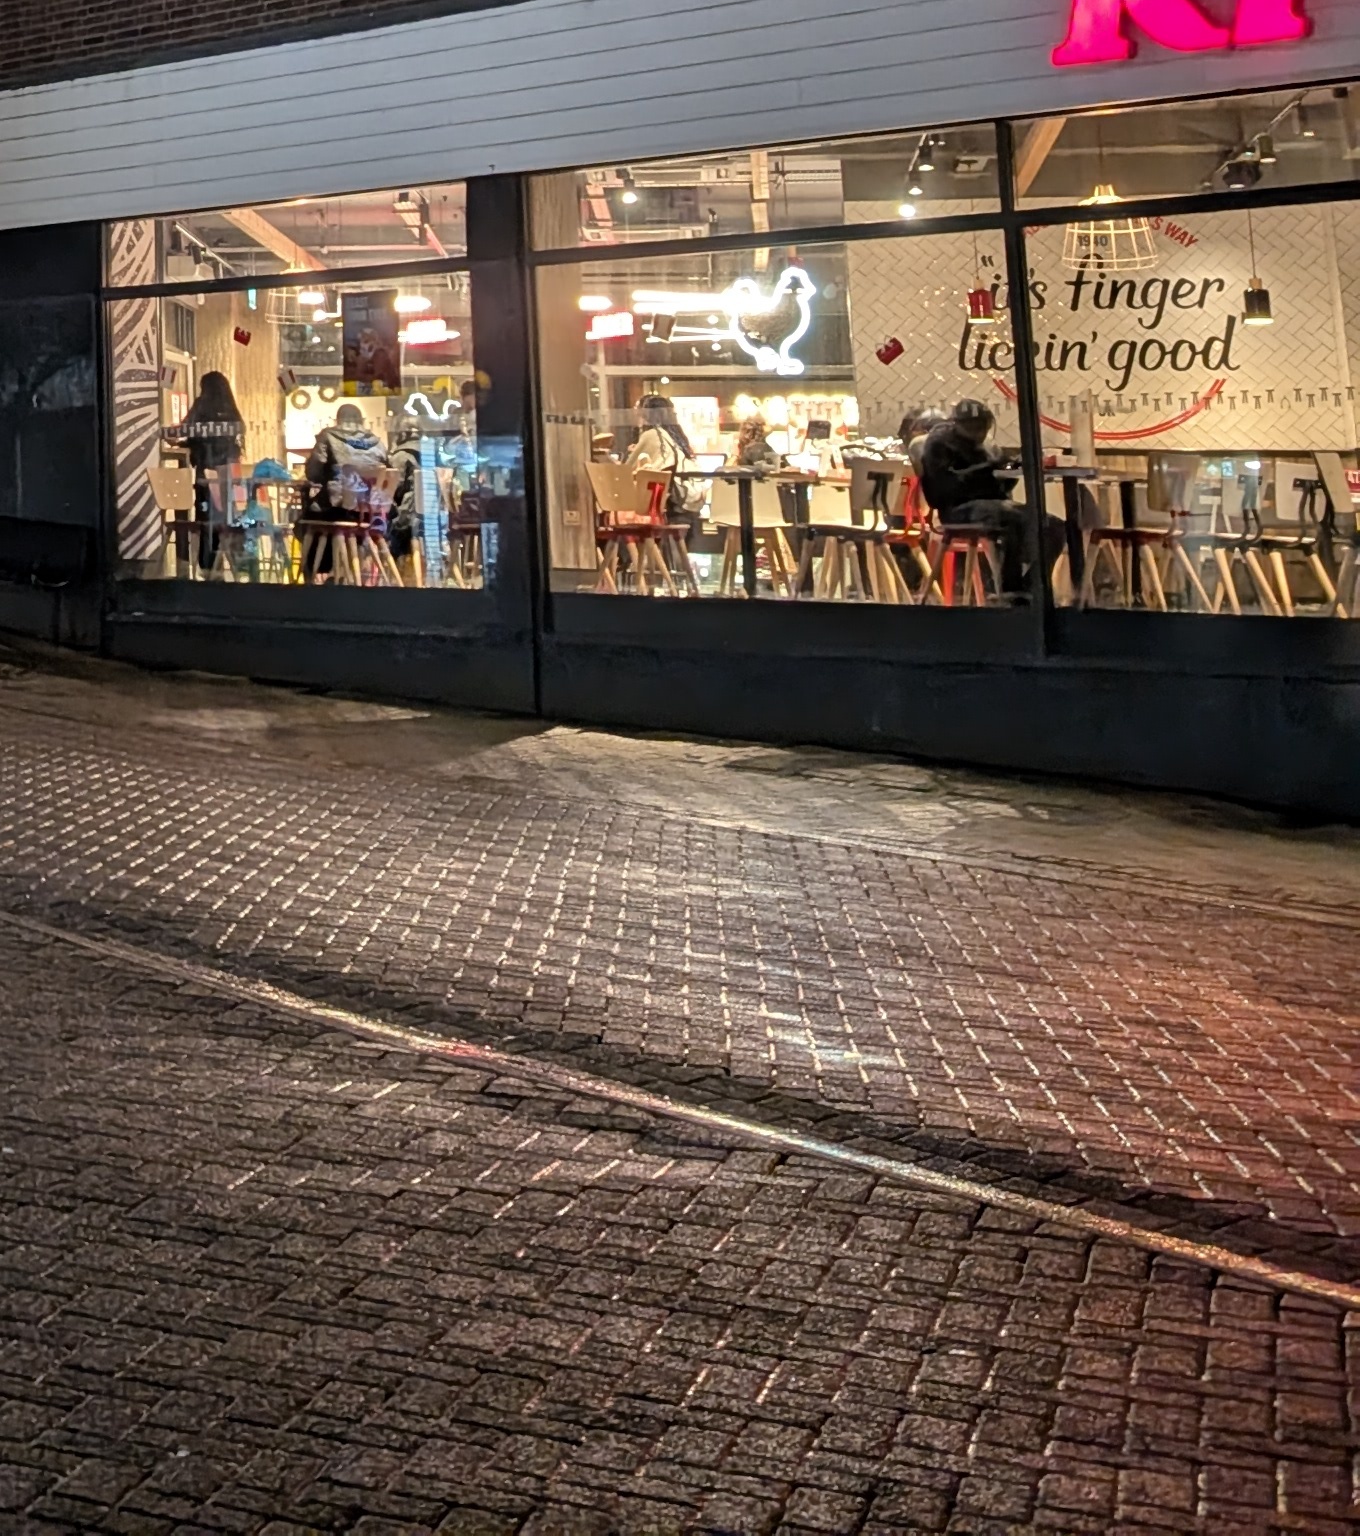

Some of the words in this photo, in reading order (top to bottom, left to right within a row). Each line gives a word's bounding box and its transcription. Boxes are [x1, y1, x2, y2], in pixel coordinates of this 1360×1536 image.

[1164, 221, 1198, 249] WAY
[1065, 253, 1224, 330] finger
[959, 315, 1098, 372] licin'
[1105, 315, 1240, 391] good
